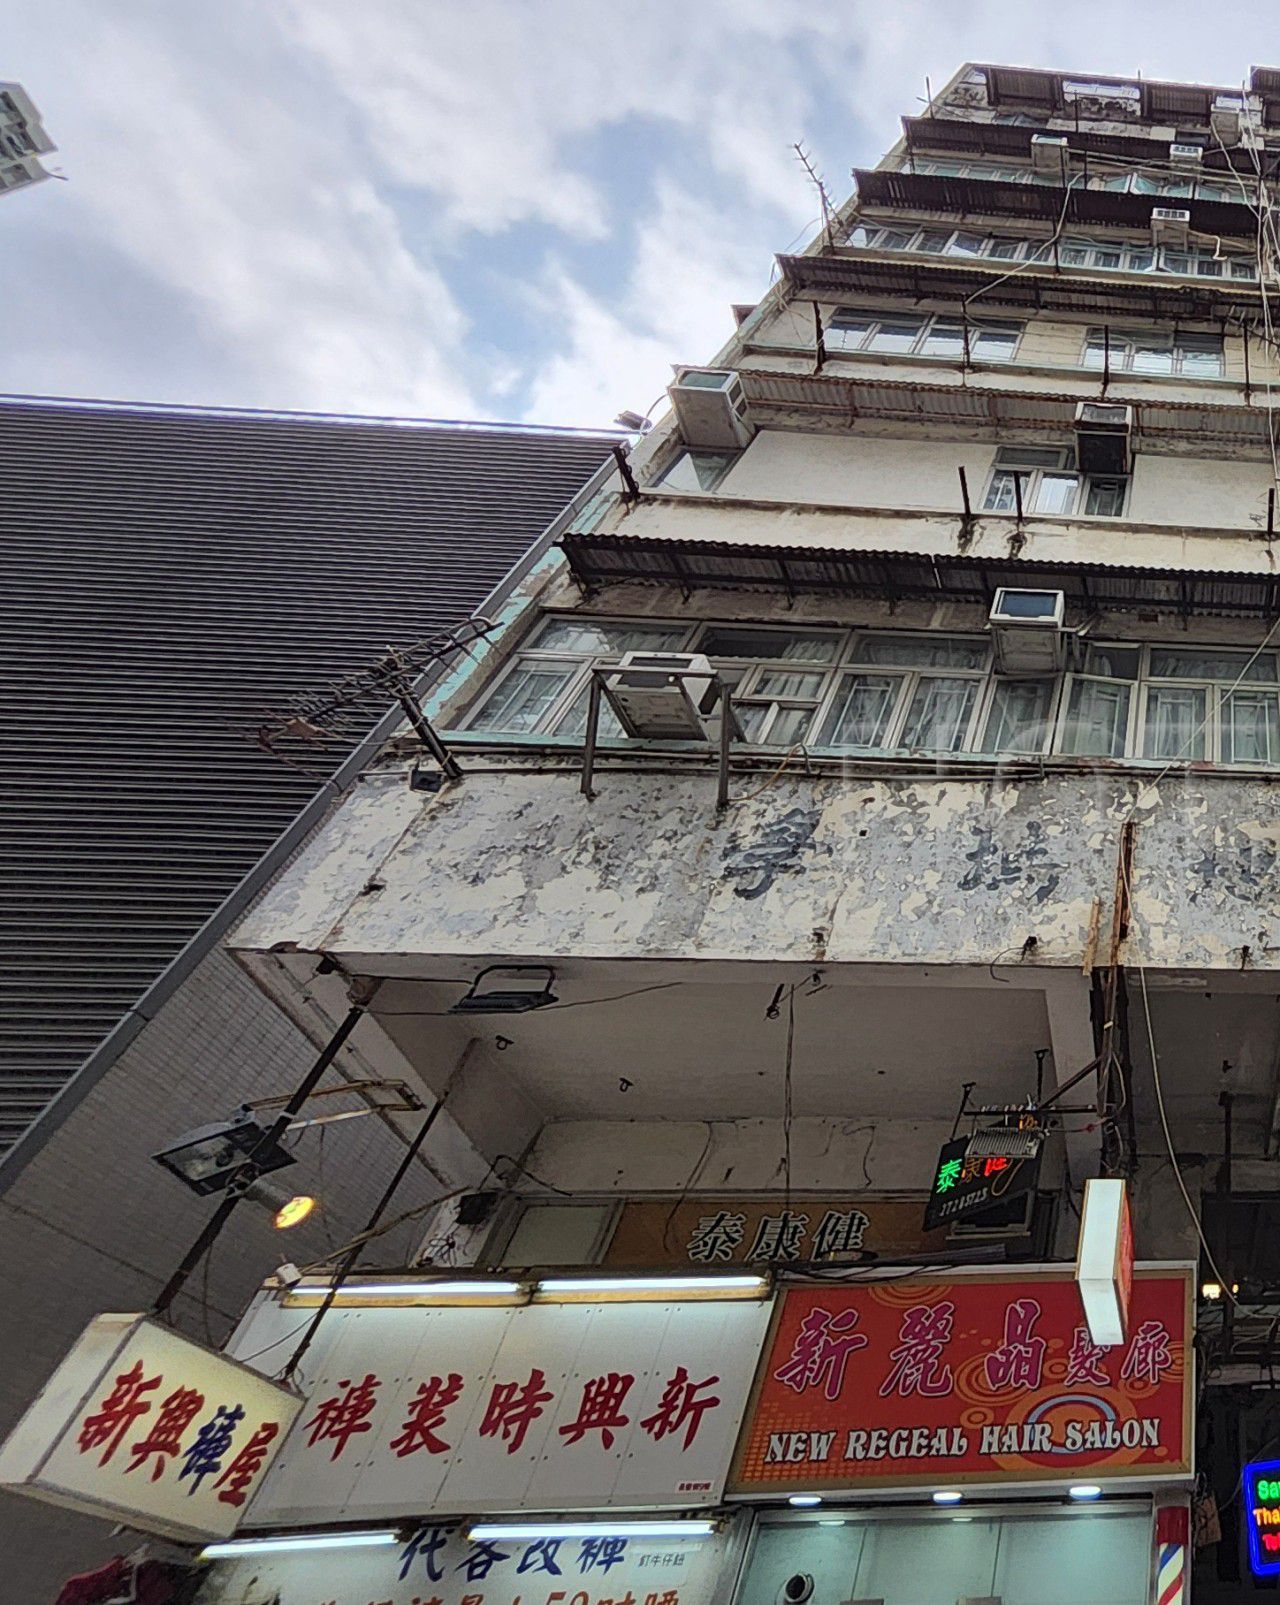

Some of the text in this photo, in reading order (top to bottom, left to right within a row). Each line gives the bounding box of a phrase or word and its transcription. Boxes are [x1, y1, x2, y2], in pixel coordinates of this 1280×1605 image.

[687, 1210, 870, 1262] 泰康健
[774, 1299, 1172, 1400] 新麗晶髮廊
[77, 1359, 279, 1507] 新興褲屋
[764, 1417, 1162, 1463] NEW REGEAL HAIR SALON
